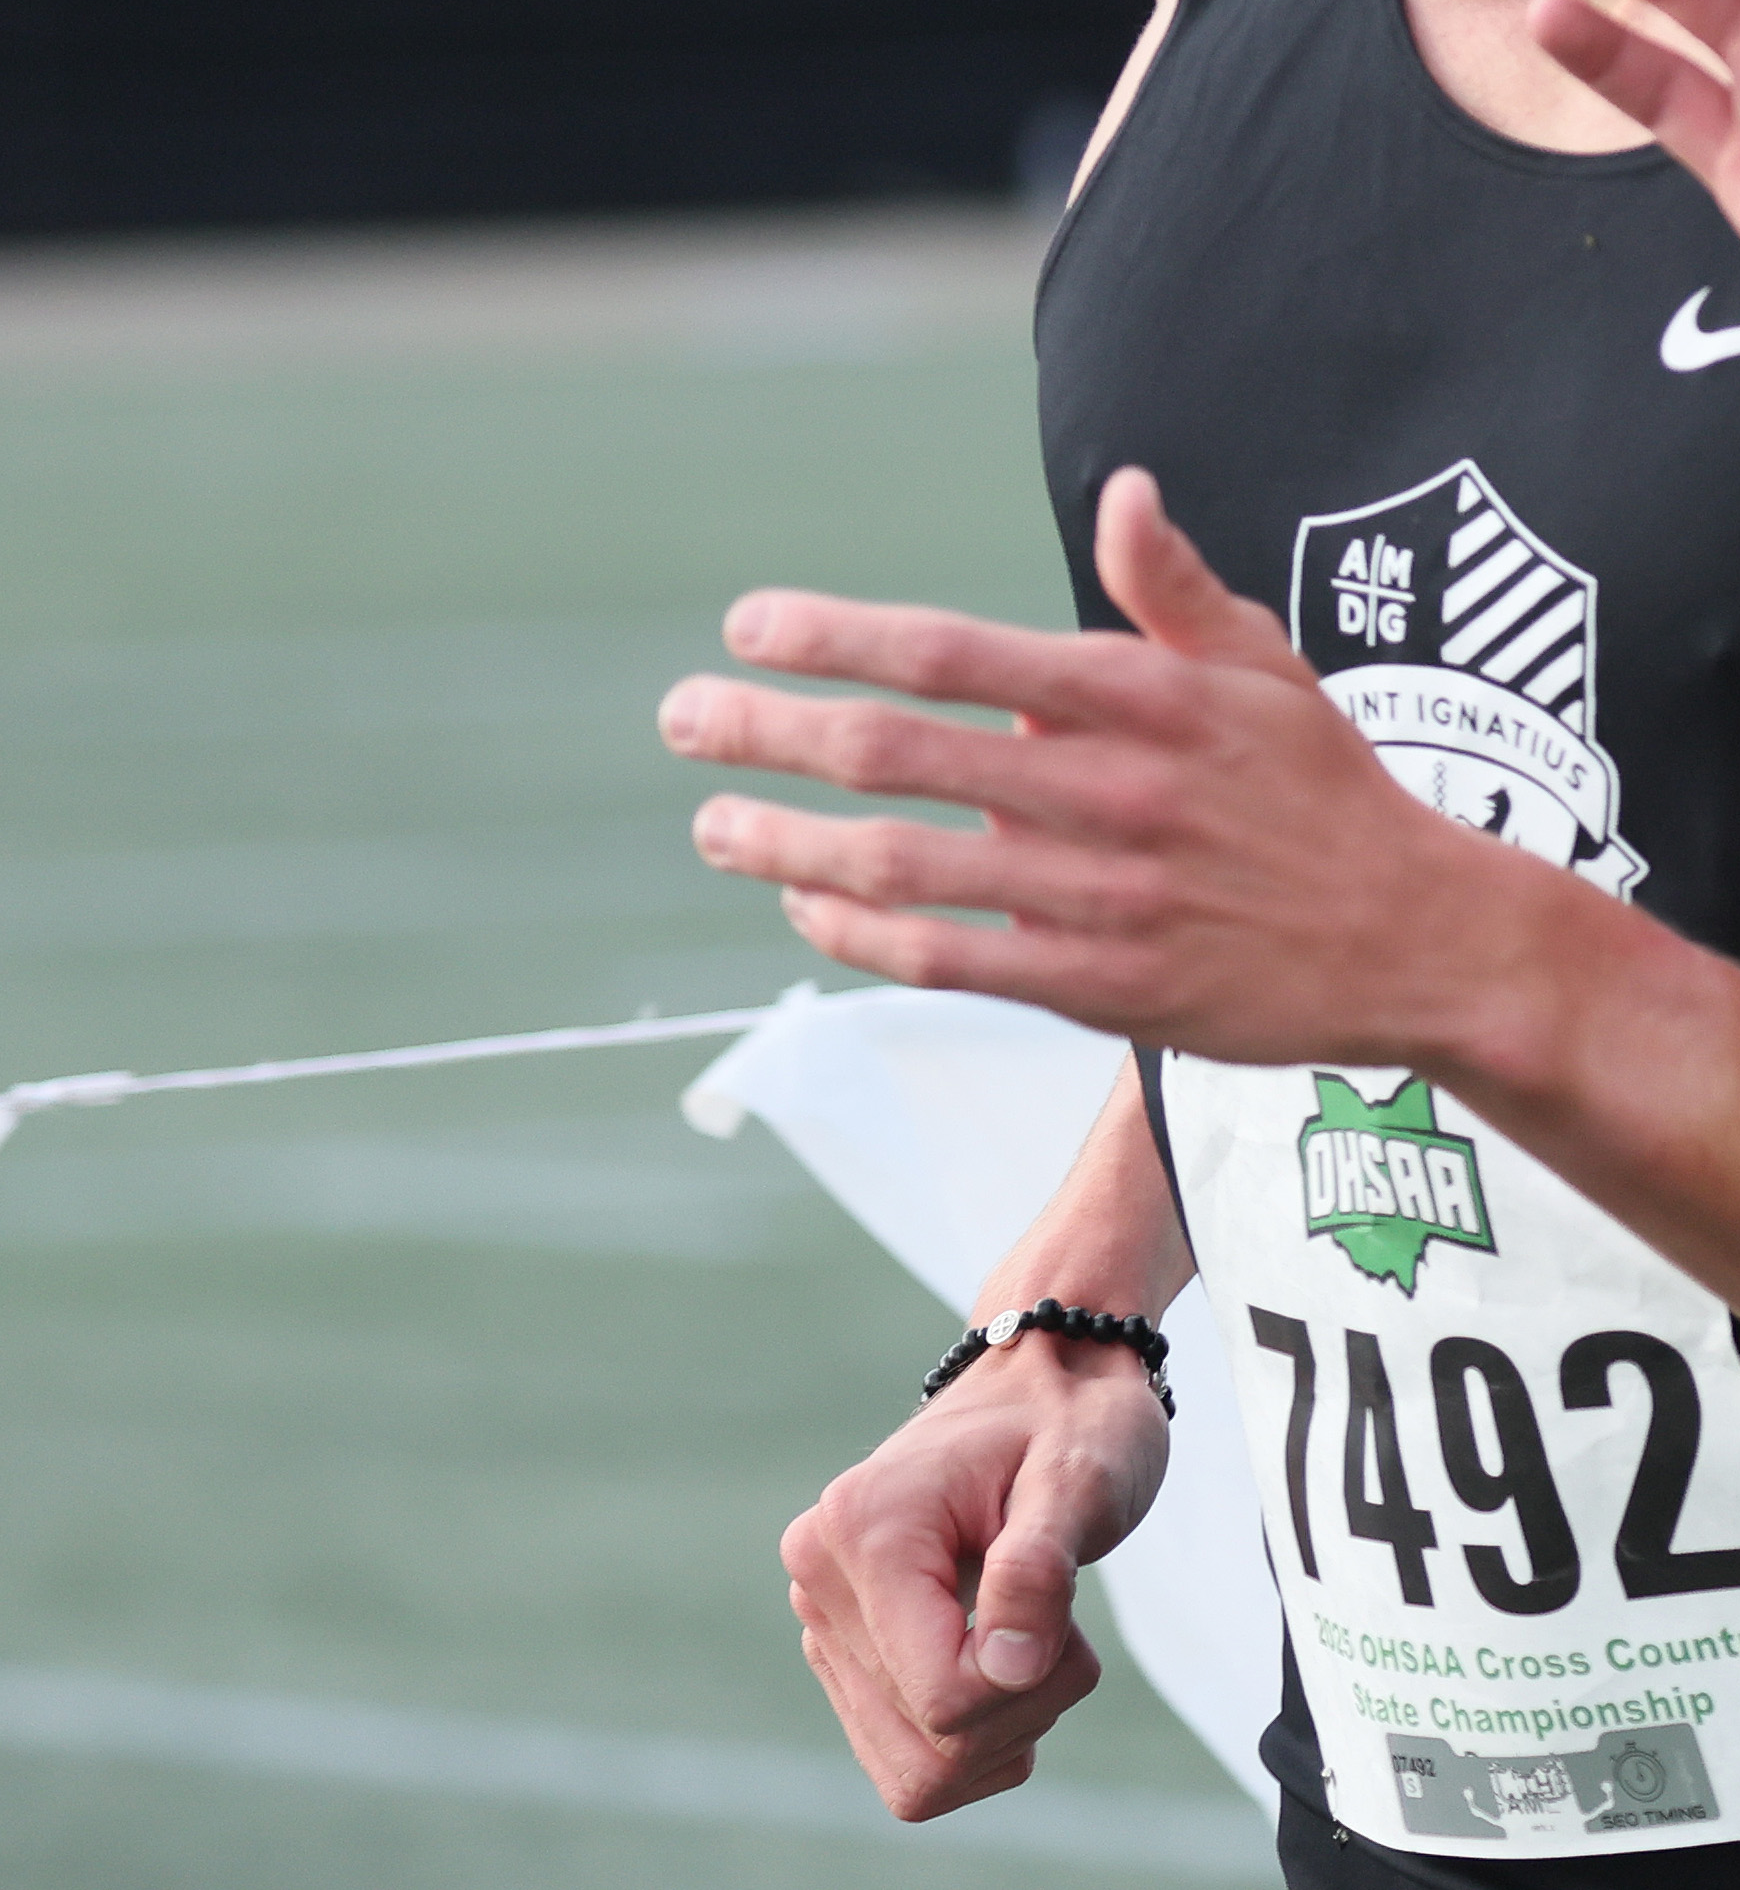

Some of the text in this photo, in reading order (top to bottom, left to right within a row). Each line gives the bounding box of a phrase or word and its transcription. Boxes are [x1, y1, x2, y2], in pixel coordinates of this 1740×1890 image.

[1349, 692, 1589, 791] INT IGNATIUS
[1306, 1127, 1482, 1238] OHSAA
[1313, 1611, 1355, 1661] 2025
[1359, 1633, 1467, 1680] OHSAA
[1475, 1646, 1592, 1680] Cross
[1353, 1681, 1715, 1741] State Championship
[1645, 1804, 1707, 1826] TIMING
